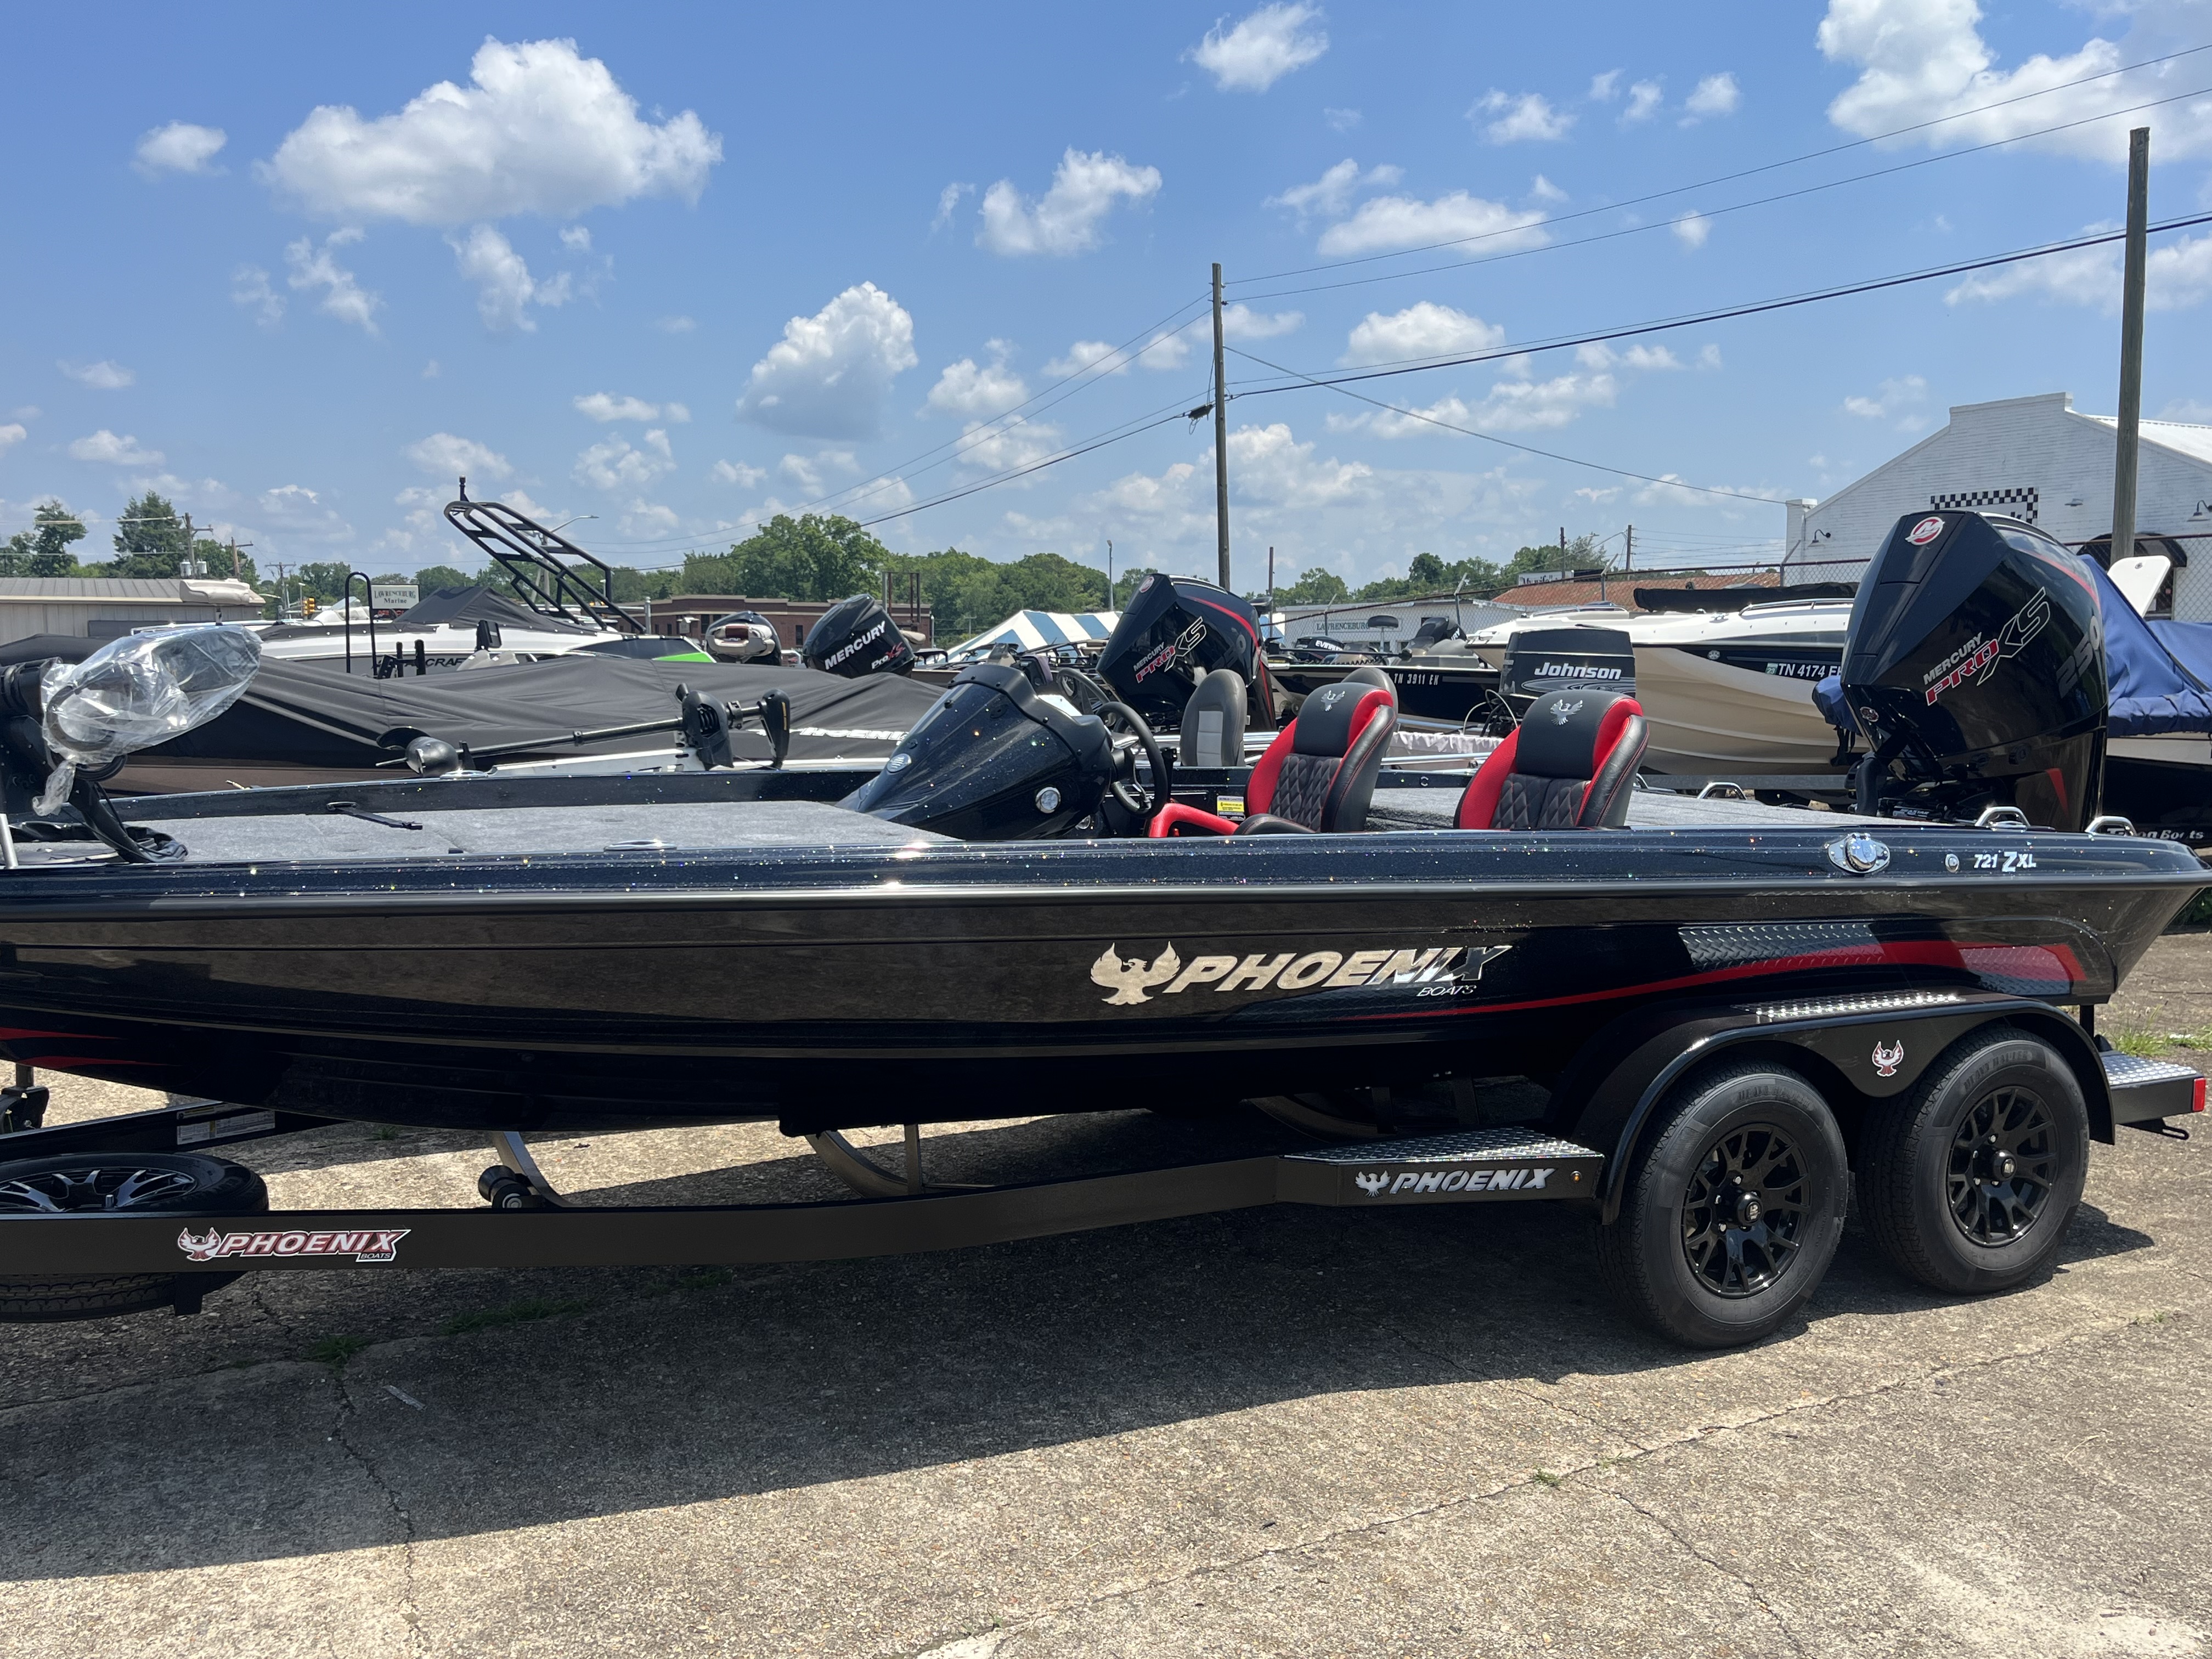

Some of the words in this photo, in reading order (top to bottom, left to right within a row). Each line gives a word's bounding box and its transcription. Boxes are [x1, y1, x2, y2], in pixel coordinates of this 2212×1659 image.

[374, 590, 416, 599] LAWRENCEBURG
[825, 620, 886, 670] MERCURY
[1133, 641, 1165, 672] MERCURY
[2056, 615, 2101, 699] 250
[871, 654, 889, 670] Pro
[1135, 645, 1176, 684] PRO
[1779, 663, 1796, 676] TN
[1797, 664, 1826, 678] 4174
[1923, 631, 1982, 685] MERCURY
[1394, 673, 1404, 684] TN
[1407, 673, 1426, 685] 3911
[1534, 662, 1622, 680] Johnson
[1925, 639, 2000, 706] PRO
[1973, 854, 1999, 868] 721
[2001, 851, 2037, 873] ZXL
[1163, 945, 1513, 994] PHOENIX
[1417, 984, 1477, 997] BOATS
[1389, 1167, 1557, 1194] PHOENIX
[218, 1231, 406, 1255] PHOENIX
